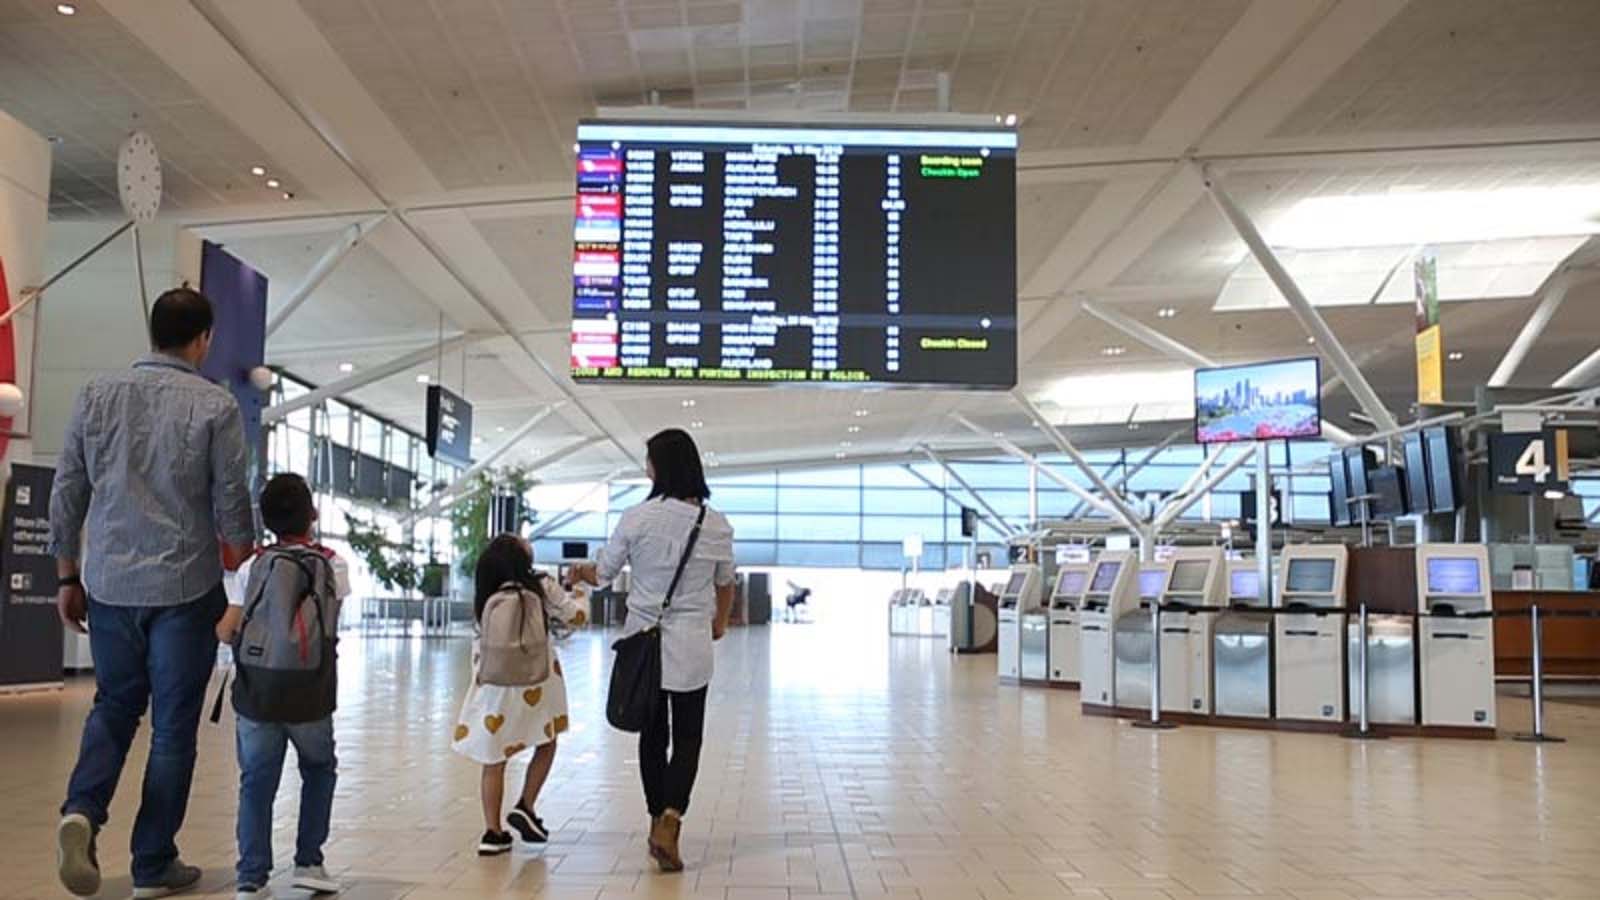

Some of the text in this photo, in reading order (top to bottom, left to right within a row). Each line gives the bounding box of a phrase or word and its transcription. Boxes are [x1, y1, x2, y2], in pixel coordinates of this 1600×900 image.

[921, 155, 960, 167] Boarding
[957, 168, 979, 178] Open
[957, 337, 988, 349] Closed
[627, 368, 671, 378] REMOVED
[675, 368, 694, 378] FOR
[699, 368, 741, 379] FURTHER
[747, 369, 806, 379] INSPECTION
[1515, 439, 1551, 483] 4
